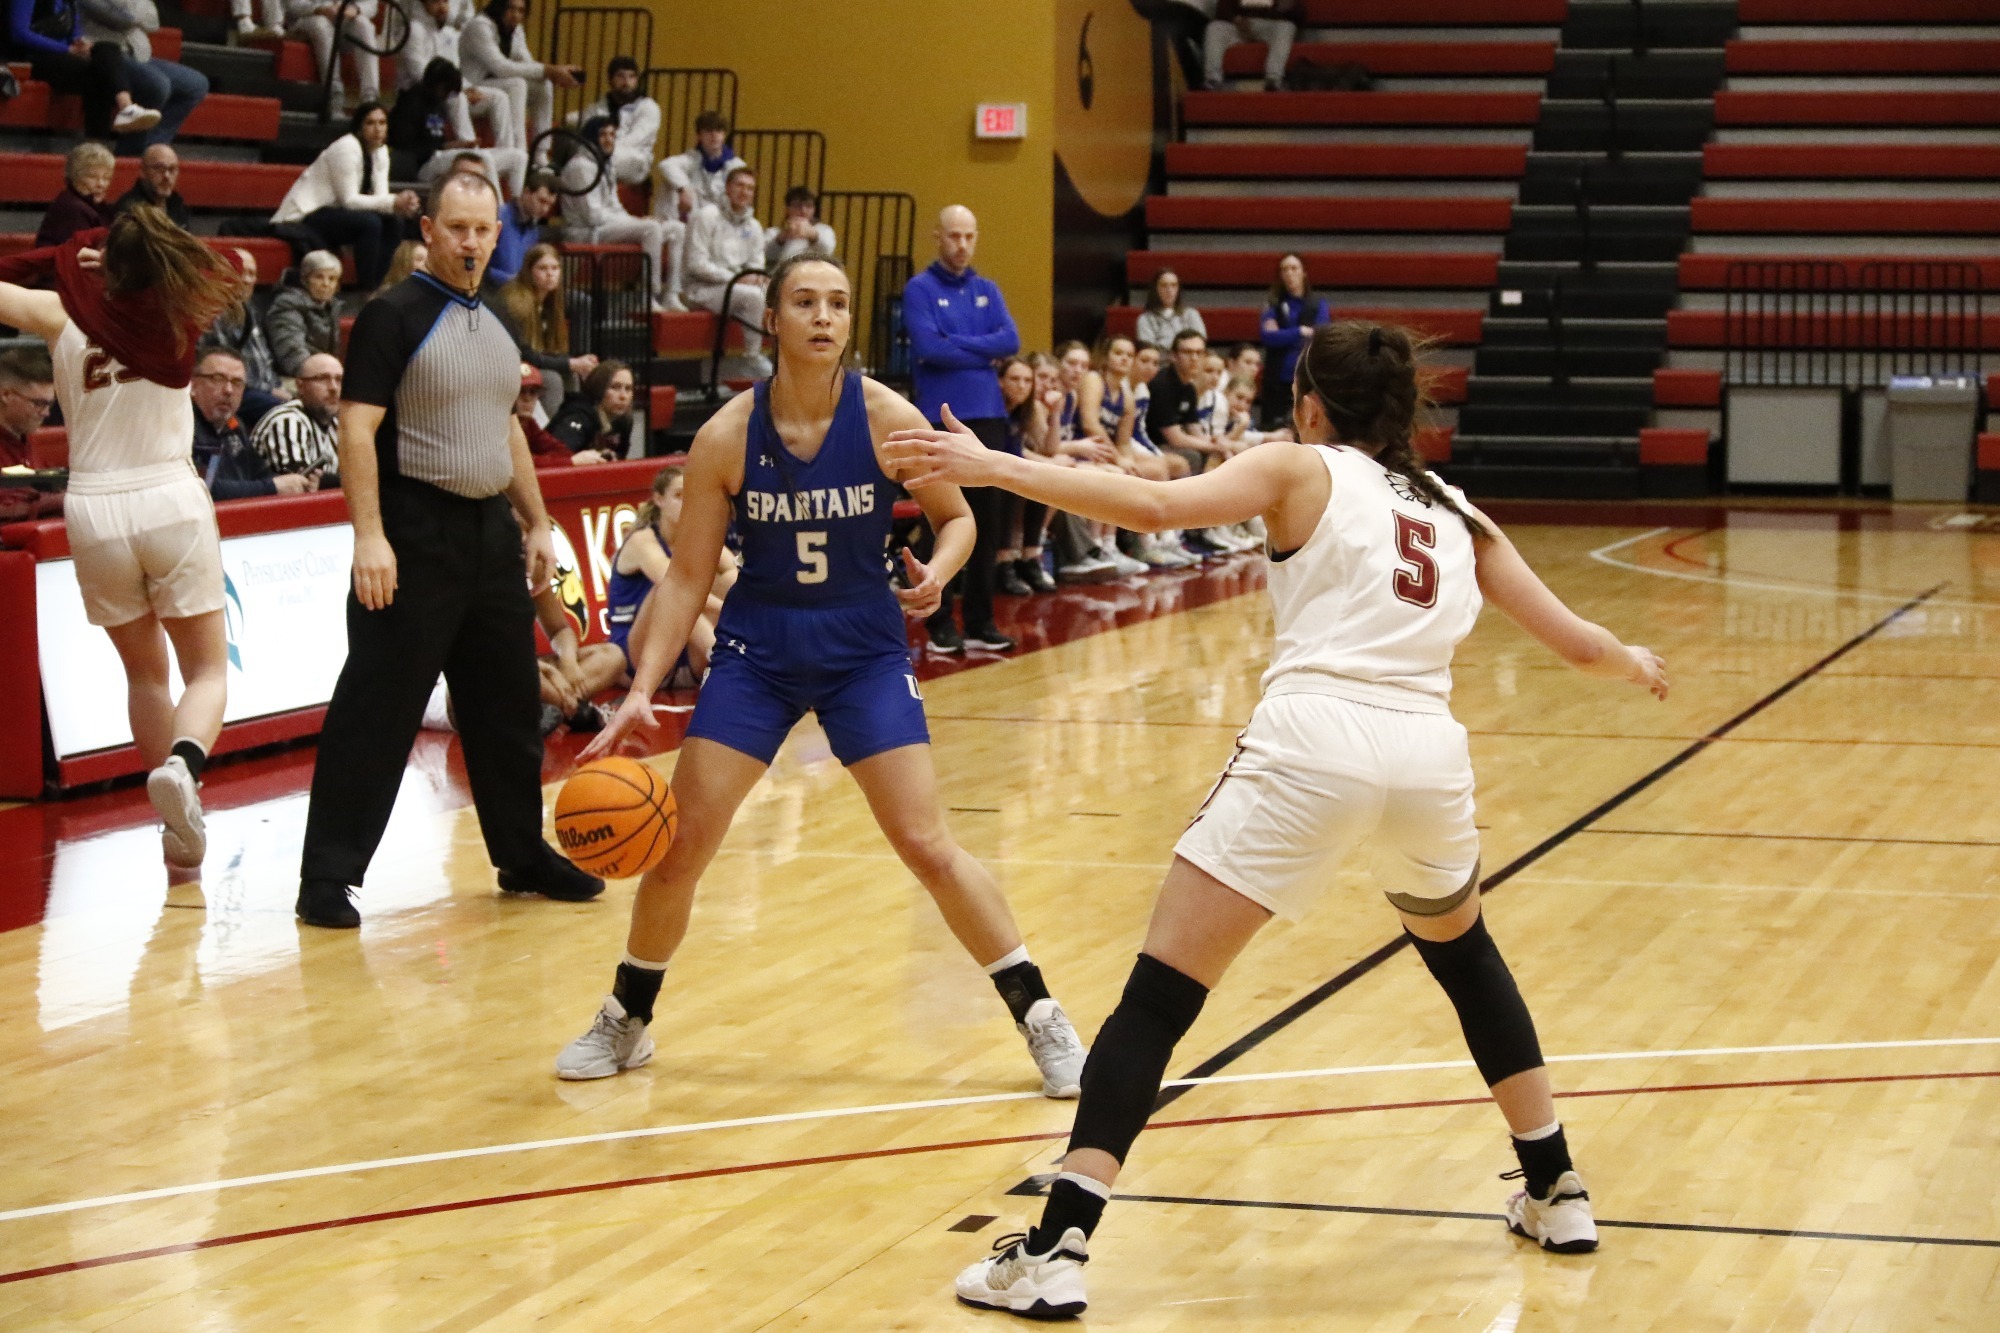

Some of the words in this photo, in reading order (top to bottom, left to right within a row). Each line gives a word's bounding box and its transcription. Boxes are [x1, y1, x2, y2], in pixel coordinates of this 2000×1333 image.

[984, 108, 1014, 131] EXIT
[747, 483, 875, 523] SPARTANS
[796, 531, 828, 585] 5
[1392, 508, 1440, 609] 5
